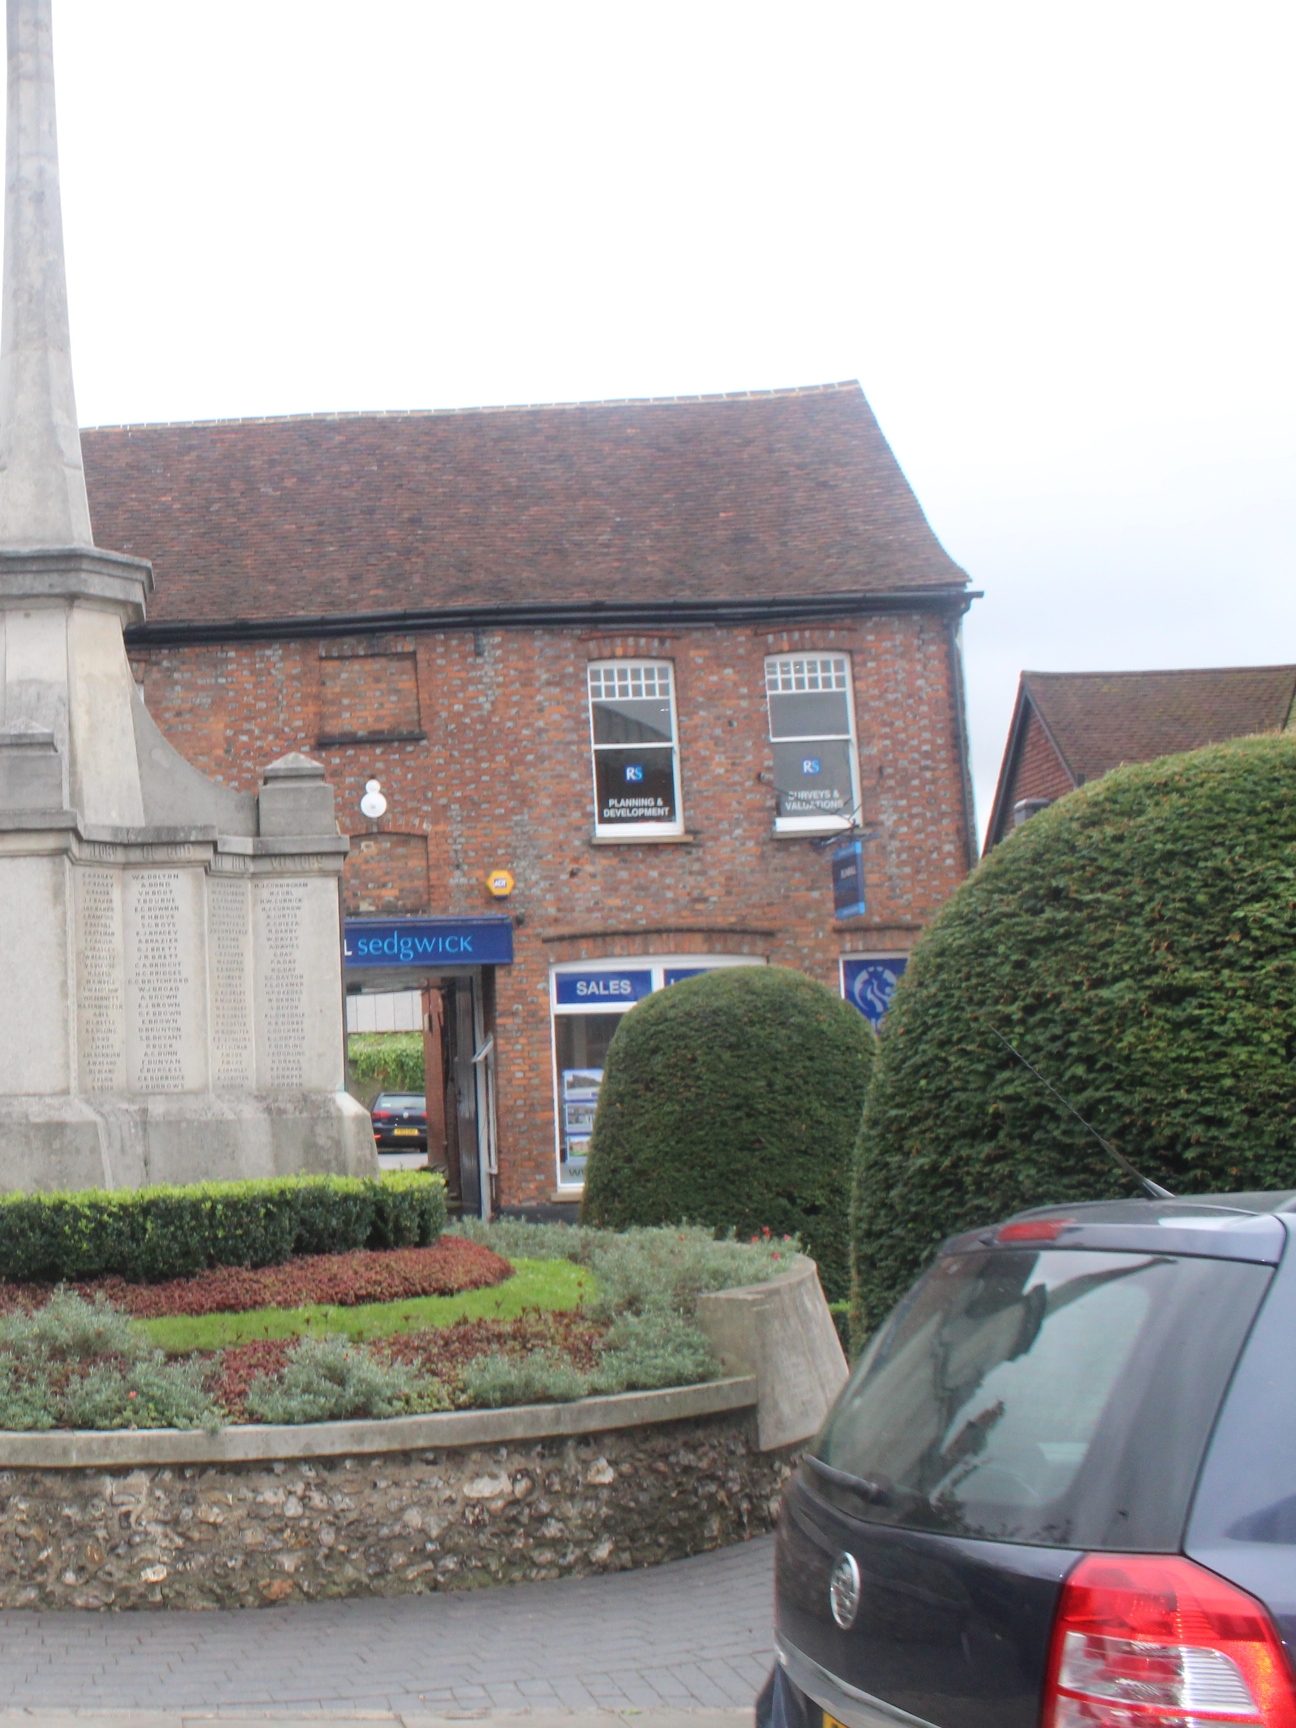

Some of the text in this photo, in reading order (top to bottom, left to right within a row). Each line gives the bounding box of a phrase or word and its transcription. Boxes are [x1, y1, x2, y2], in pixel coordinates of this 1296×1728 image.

[626, 766, 643, 781] RS
[788, 790, 831, 800] SURVEYS
[608, 798, 656, 808] PLANNING
[785, 800, 844, 810] VALUATIONS
[604, 806, 670, 817] DEVELOPMENT
[358, 930, 473, 962] sedgwick
[576, 979, 632, 996] SALES
